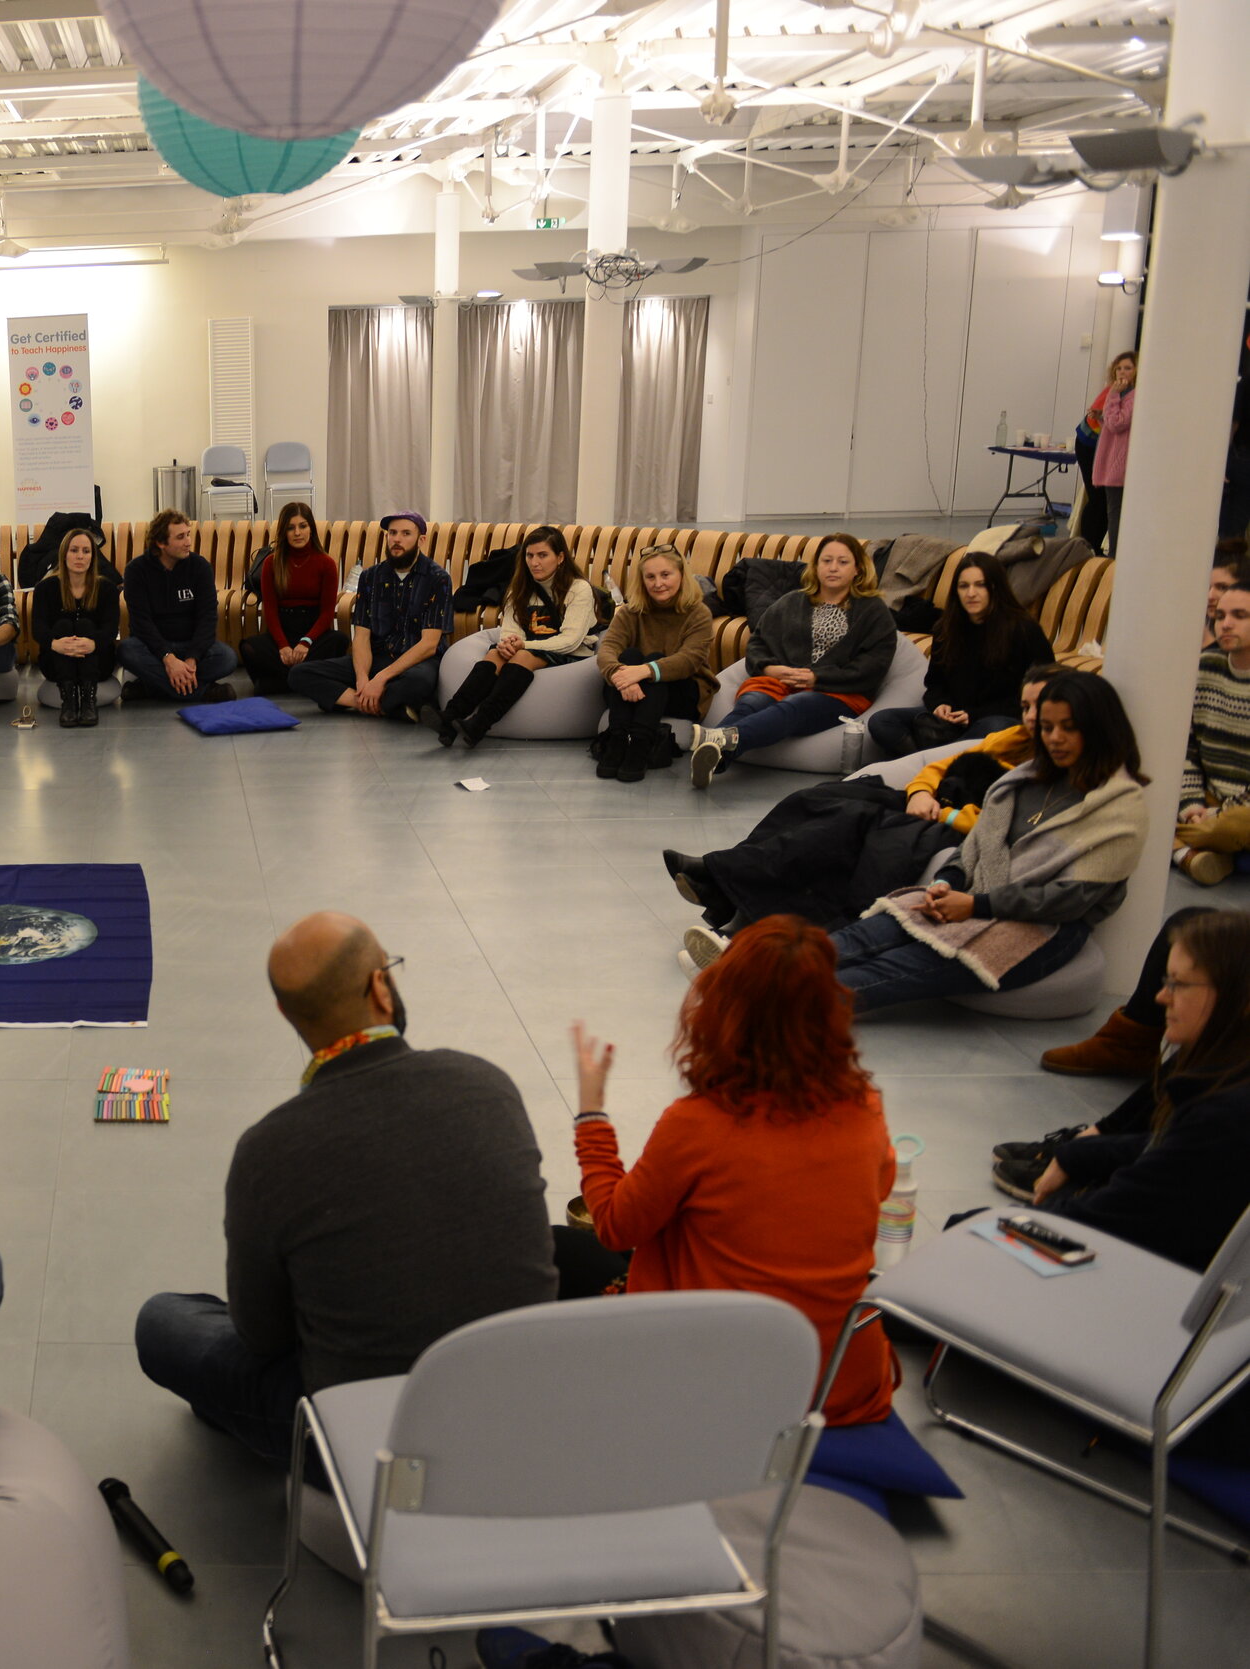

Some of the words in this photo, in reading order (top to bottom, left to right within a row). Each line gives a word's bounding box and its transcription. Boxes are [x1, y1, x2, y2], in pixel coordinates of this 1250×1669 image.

[10, 334, 31, 344] Get
[35, 330, 86, 343] Certified
[21, 346, 43, 354] Teach
[45, 346, 86, 354] Happiness
